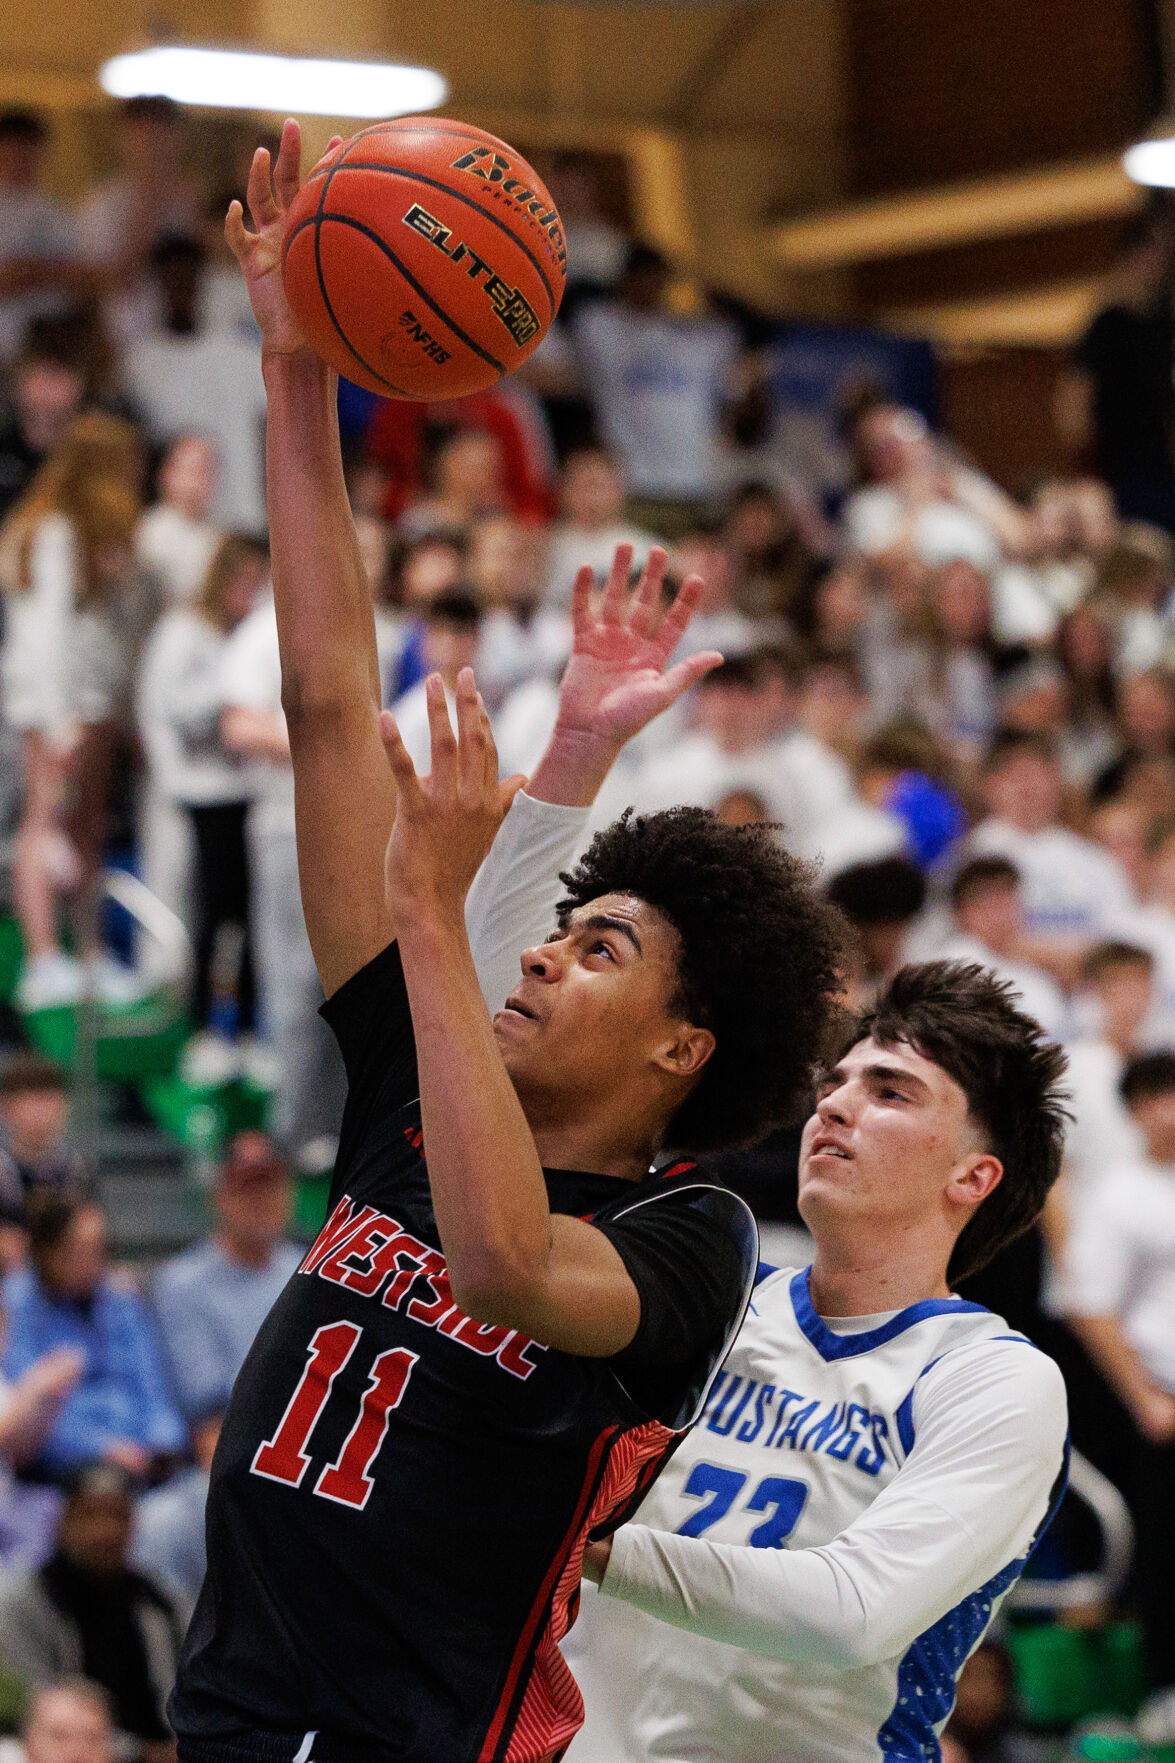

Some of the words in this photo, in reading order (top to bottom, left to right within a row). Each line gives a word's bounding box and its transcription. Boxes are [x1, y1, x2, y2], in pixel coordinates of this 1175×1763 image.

[449, 146, 567, 276] Baden
[406, 323, 451, 364] NFHS
[249, 1319, 420, 1511] 11
